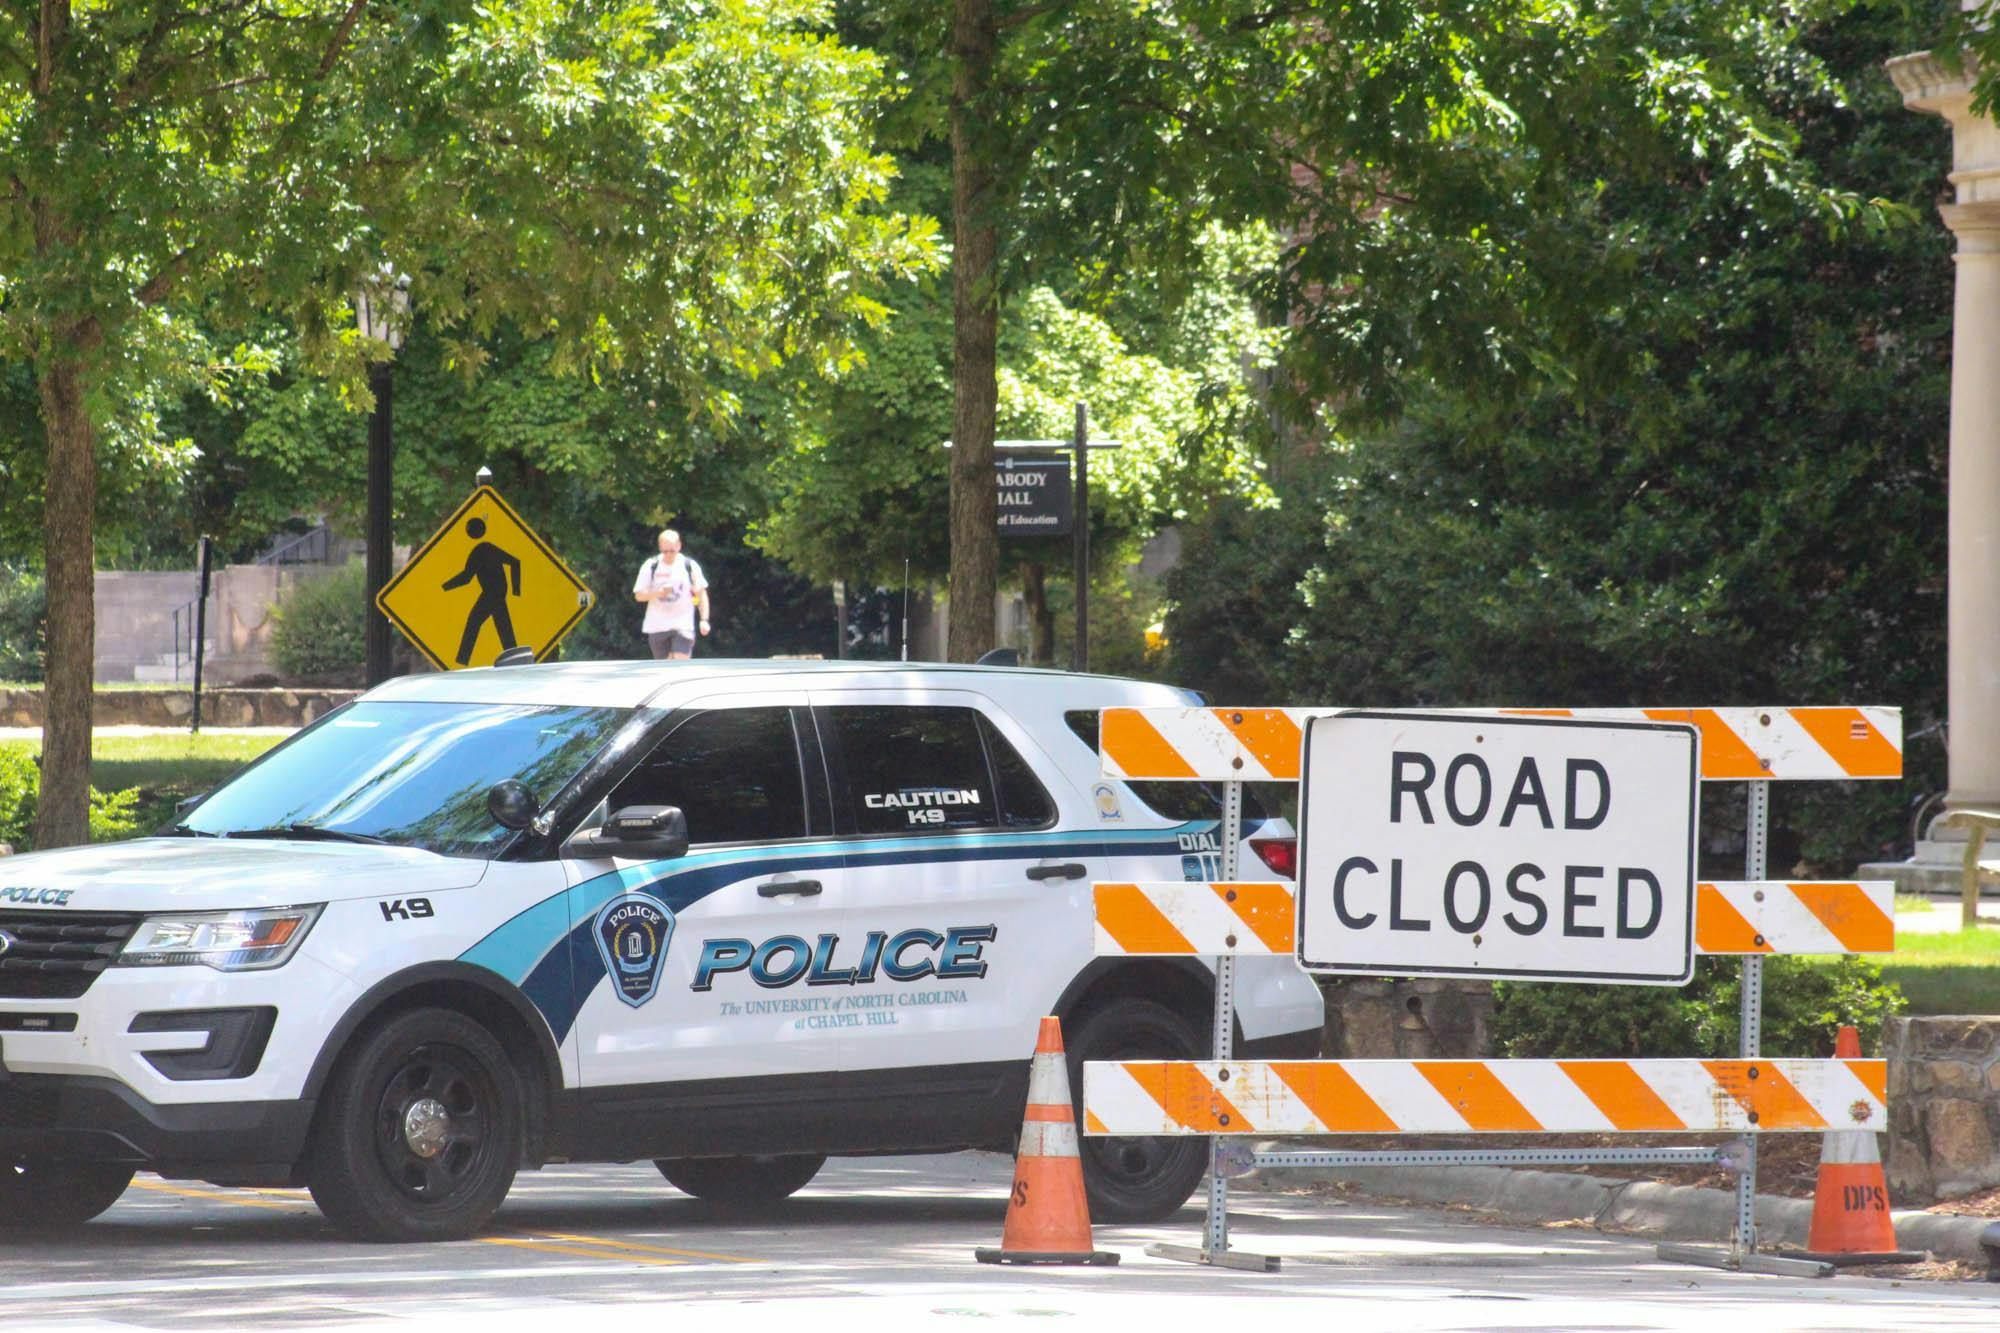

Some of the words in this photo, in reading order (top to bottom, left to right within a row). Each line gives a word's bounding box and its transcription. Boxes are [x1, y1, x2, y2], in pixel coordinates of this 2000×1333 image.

[996, 473, 1047, 487] ABODY
[997, 514, 1008, 525] of
[1010, 515, 1058, 525] Education
[864, 789, 980, 808] CAUTION
[1390, 751, 1611, 830] ROAD
[907, 809, 945, 824] K9
[1177, 832, 1222, 851] DIAL
[1333, 856, 1662, 939] CLOSED
[379, 898, 434, 922] K9
[609, 905, 660, 928] POLICE
[689, 923, 998, 993] POLICE
[720, 1002, 741, 1017] The
[745, 997, 831, 1015] UNIVERSITY
[832, 996, 844, 1013] of
[846, 993, 894, 1009] NORTH
[898, 989, 968, 1007] CAROLINA
[807, 1012, 863, 1029] CHAPEL
[866, 1010, 899, 1026] HILL
[1843, 1185, 1885, 1212] DPS
